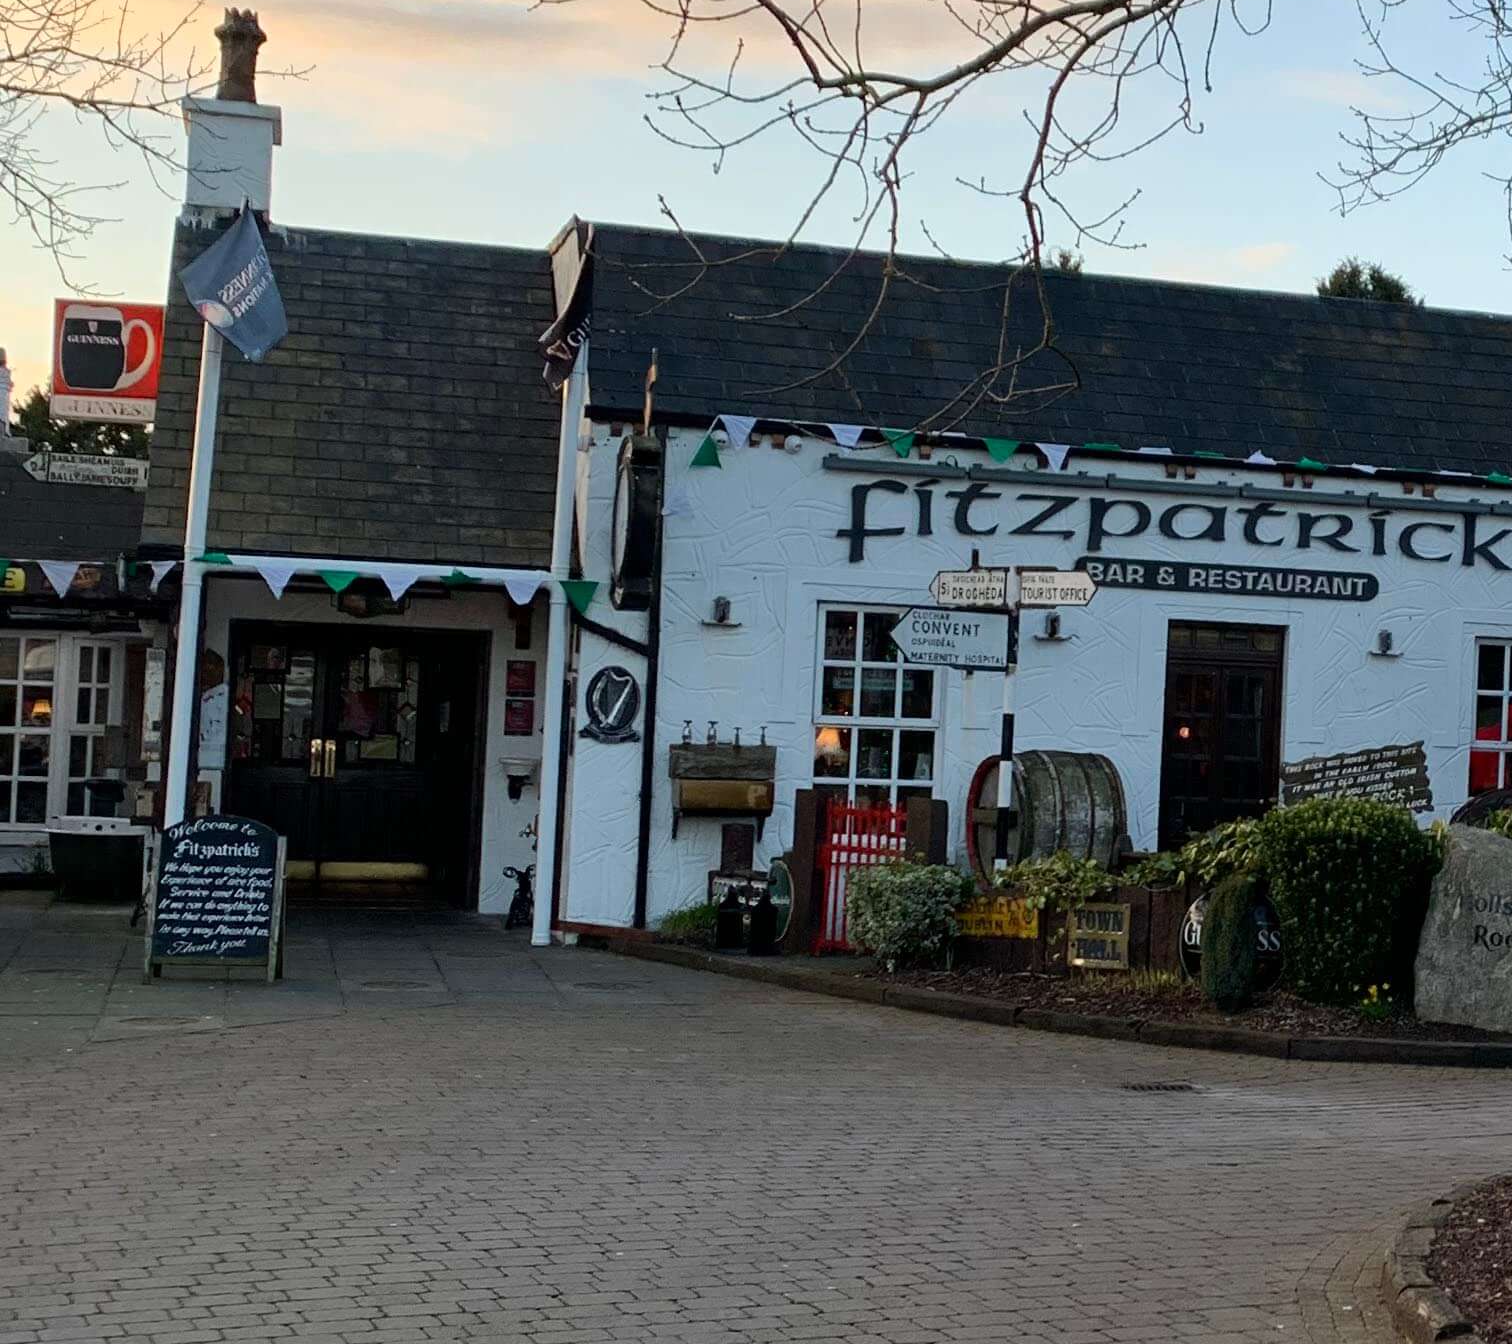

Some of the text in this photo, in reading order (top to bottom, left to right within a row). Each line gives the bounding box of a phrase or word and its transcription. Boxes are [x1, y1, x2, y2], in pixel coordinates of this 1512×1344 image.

[66, 334, 120, 346] GUINNESS
[1087, 563, 1369, 596] BAR & RESTAURANT
[1022, 587, 1089, 601] TOURIST OFFICE
[912, 620, 980, 637] CONVENT
[911, 652, 1005, 665] MATERNITY HOSPITAL
[1342, 765, 1369, 775] EARLY
[1338, 777, 1354, 786] OLD
[1356, 774, 1382, 783] IRISH
[1384, 768, 1417, 779] CUSTOM
[169, 819, 260, 840] Welcome to
[173, 839, 260, 859] Fitzpatrick's
[164, 862, 179, 872] We
[204, 866, 223, 874] you
[223, 864, 249, 877] enjoy
[249, 867, 273, 878] your
[215, 876, 227, 886] of
[169, 886, 210, 897] Service
[211, 889, 234, 897] and
[185, 902, 203, 910] can
[204, 900, 217, 910] do
[216, 900, 257, 913] anything
[257, 902, 270, 912] to
[158, 912, 180, 920] make
[201, 913, 244, 924] experience
[172, 927, 192, 937] any
[243, 925, 258, 936] tell
[166, 939, 218, 955] Thank
